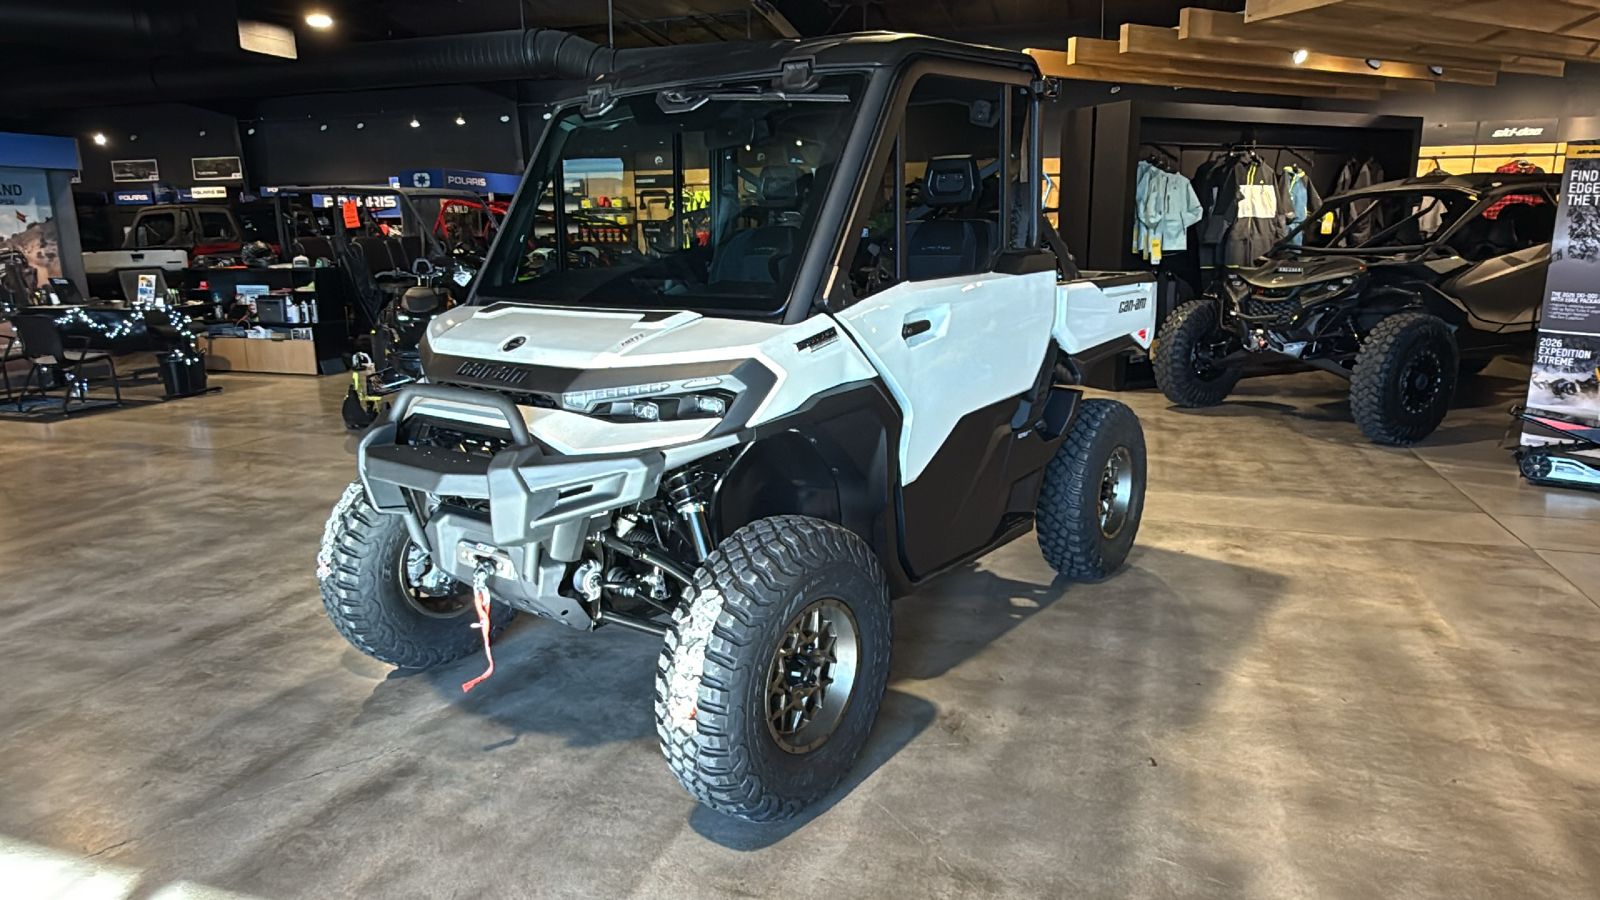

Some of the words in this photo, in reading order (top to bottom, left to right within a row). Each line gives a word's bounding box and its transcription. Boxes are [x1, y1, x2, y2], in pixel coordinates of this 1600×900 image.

[1492, 127, 1544, 137] ski-doo
[448, 175, 487, 187] POLARIS
[1570, 169, 1599, 182] FIND
[1568, 181, 1600, 194] EDGE
[1567, 193, 1592, 206] THE
[1118, 297, 1147, 313] can-am
[1540, 337, 1563, 348] 2026
[1538, 346, 1592, 360] EXPEDITION
[1537, 354, 1575, 367] XTREME
